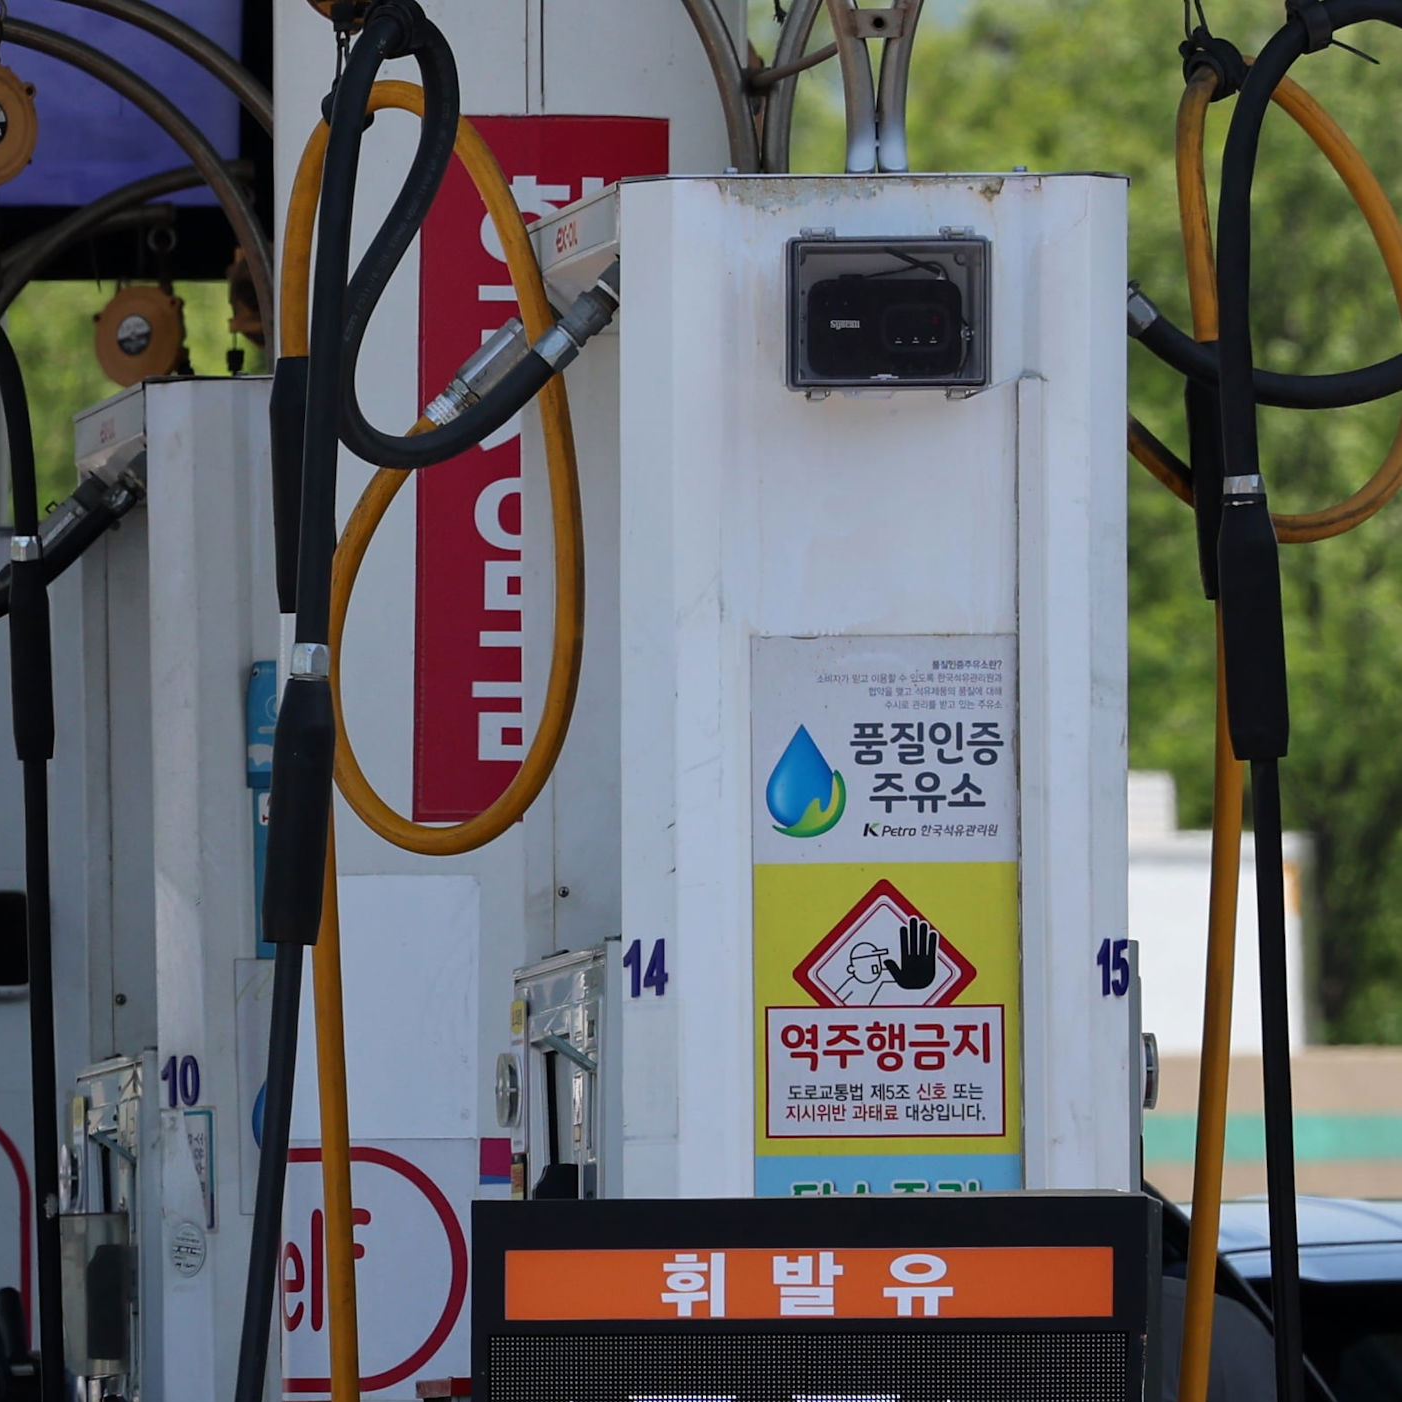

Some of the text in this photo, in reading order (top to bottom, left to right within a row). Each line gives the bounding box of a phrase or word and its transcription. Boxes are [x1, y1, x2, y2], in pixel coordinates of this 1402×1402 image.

[978, 699, 1003, 710] 주유소
[850, 721, 1004, 765] 품질인증
[869, 771, 986, 813] 주유소
[920, 824, 999, 838] 한국석유관리원
[622, 937, 669, 998] 14
[1096, 937, 1130, 997] 15
[781, 1021, 991, 1072] 역주행금지
[161, 1055, 200, 1109] 10
[787, 1082, 984, 1101] 도로교통법 제5조 신호 또는
[785, 1103, 986, 1122] 지시위반 과태료 대상입니다.
